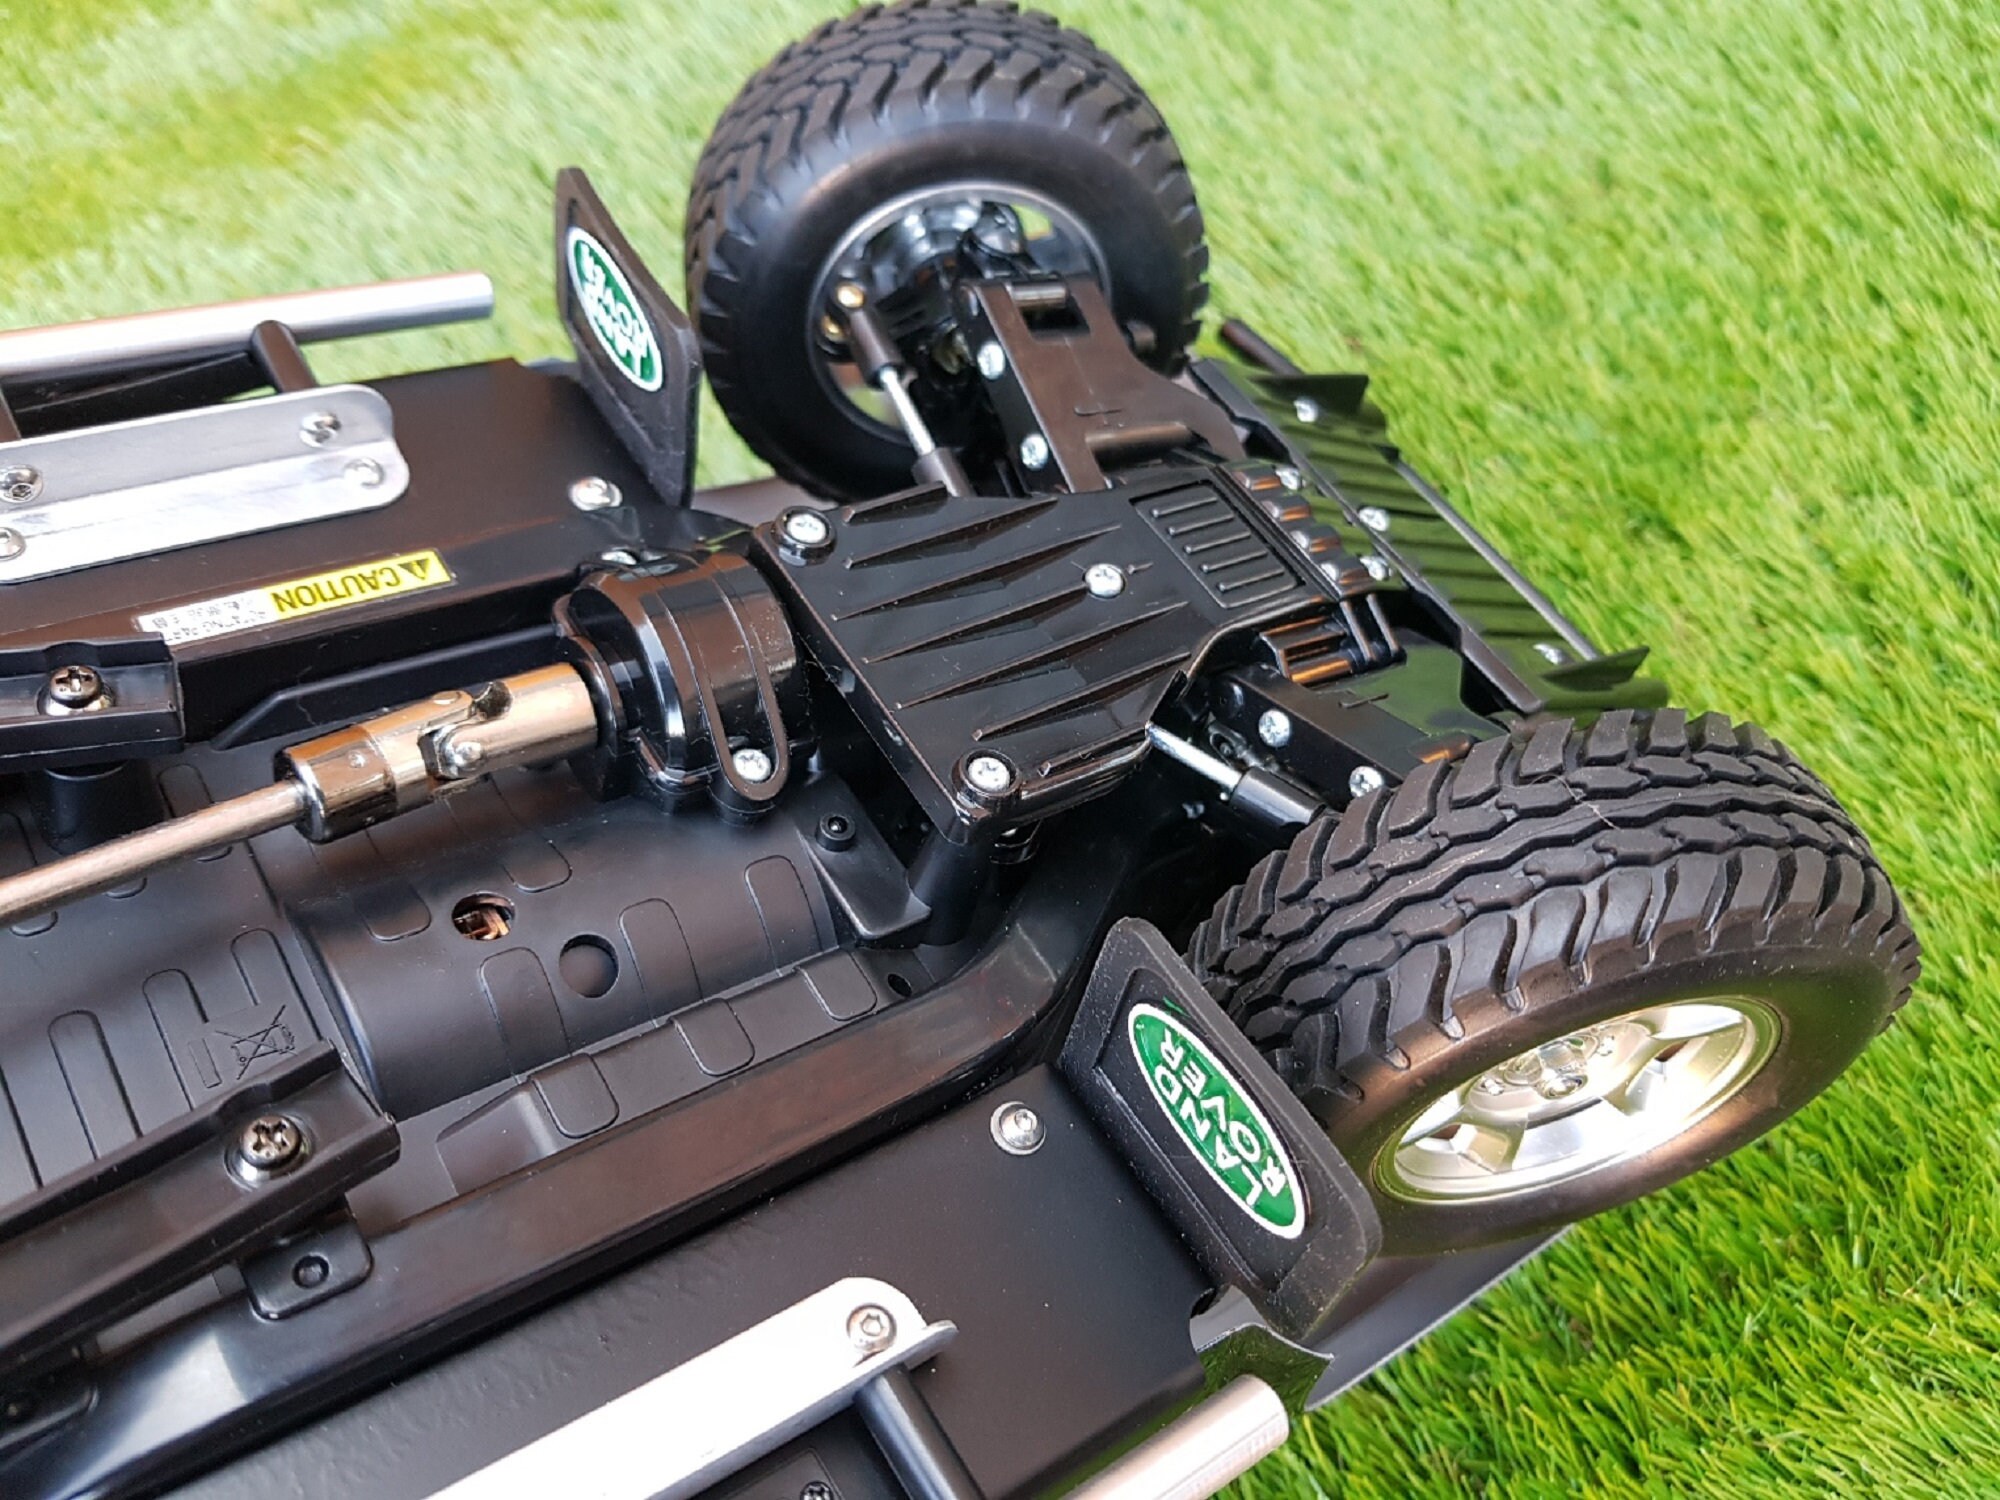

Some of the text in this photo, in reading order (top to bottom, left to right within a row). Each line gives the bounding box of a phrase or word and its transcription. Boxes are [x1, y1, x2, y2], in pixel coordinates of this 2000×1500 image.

[271, 566, 402, 612] CAUTION
[1155, 1066, 1263, 1206] LAND
[1160, 1028, 1287, 1197] ROVER
